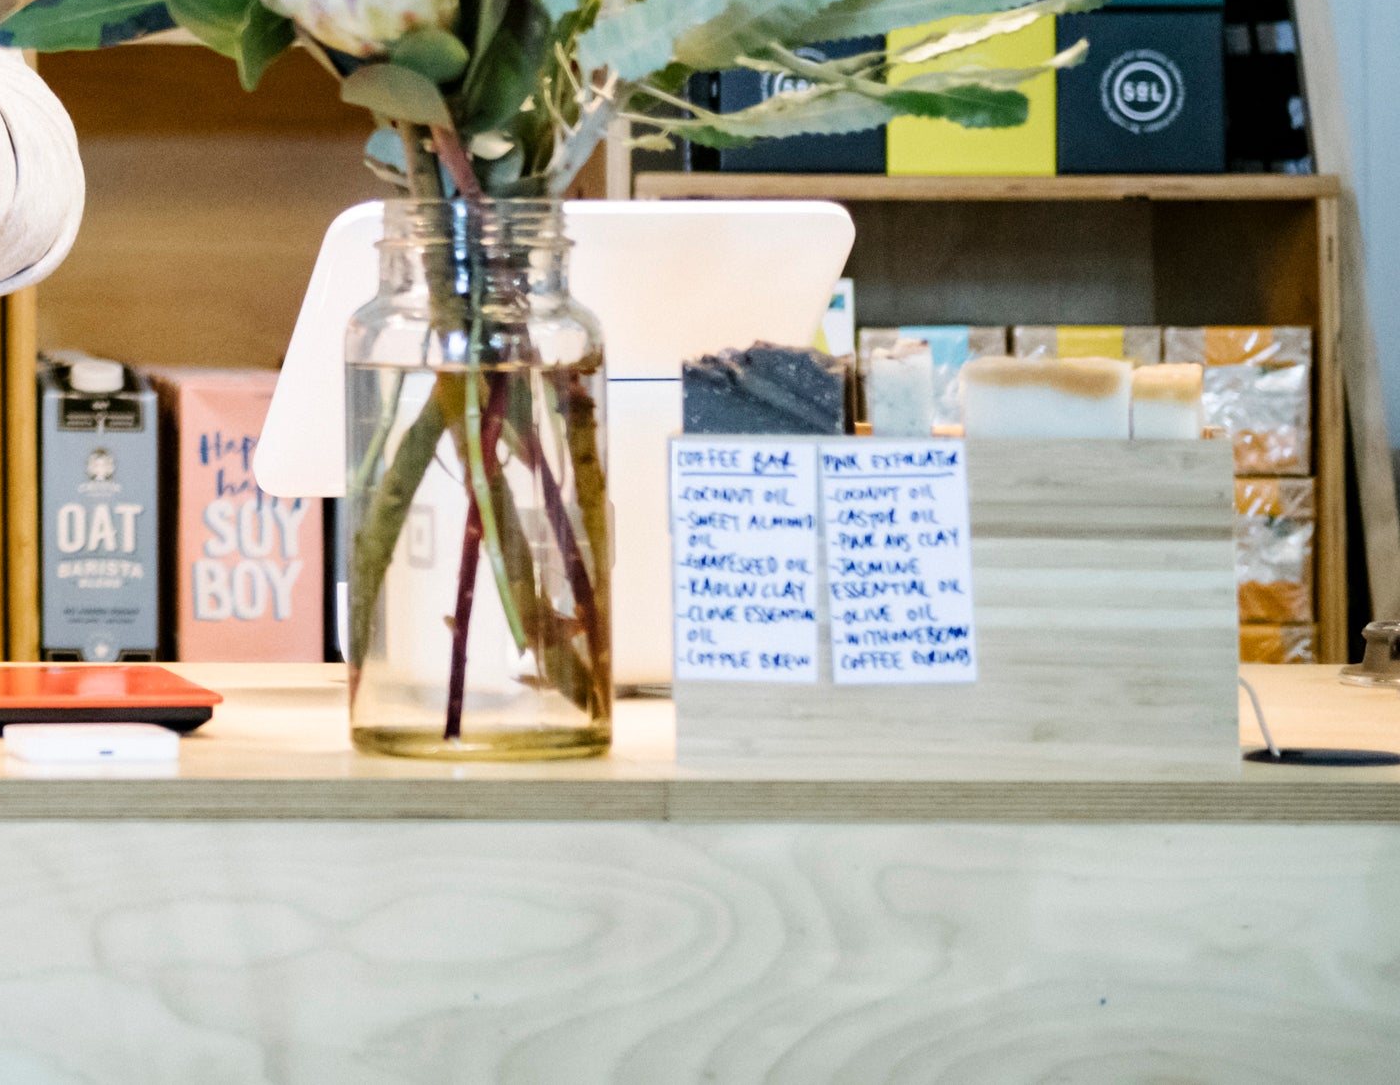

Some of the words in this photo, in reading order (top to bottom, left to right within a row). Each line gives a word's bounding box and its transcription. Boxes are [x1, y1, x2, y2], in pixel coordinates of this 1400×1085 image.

[1122, 80, 1162, 102] SOL
[200, 431, 258, 471] Hap
[57, 502, 143, 553] OAT
[203, 497, 310, 559] SOY
[57, 559, 144, 579] BARISTA
[193, 559, 303, 620] BOY
